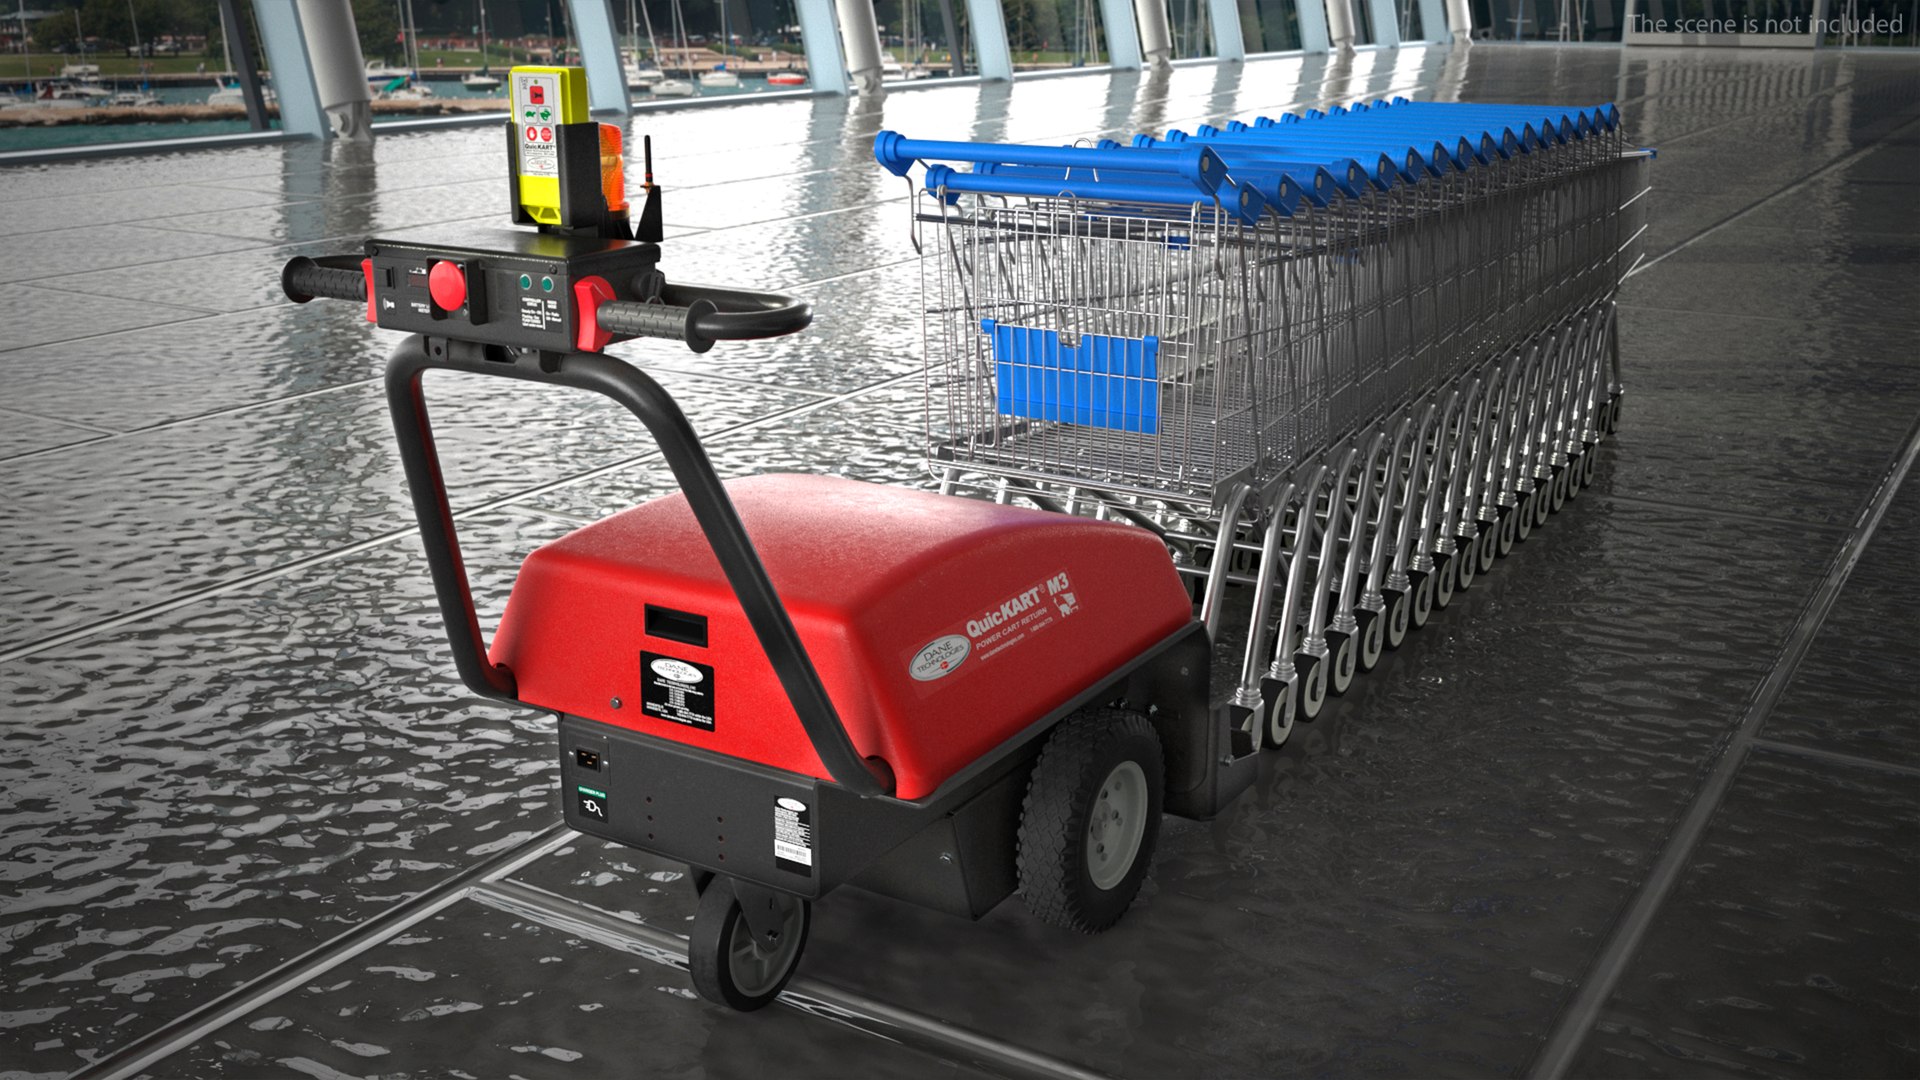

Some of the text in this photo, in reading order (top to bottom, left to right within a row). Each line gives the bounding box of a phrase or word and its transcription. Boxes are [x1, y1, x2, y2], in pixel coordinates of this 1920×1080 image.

[1046, 572, 1070, 596] M3
[975, 631, 1002, 650] POWER
[1002, 621, 1020, 636] CART
[1020, 607, 1048, 626] RETURN
[917, 645, 965, 673] TECHNOLOGIES
[923, 641, 953, 661] DANE
